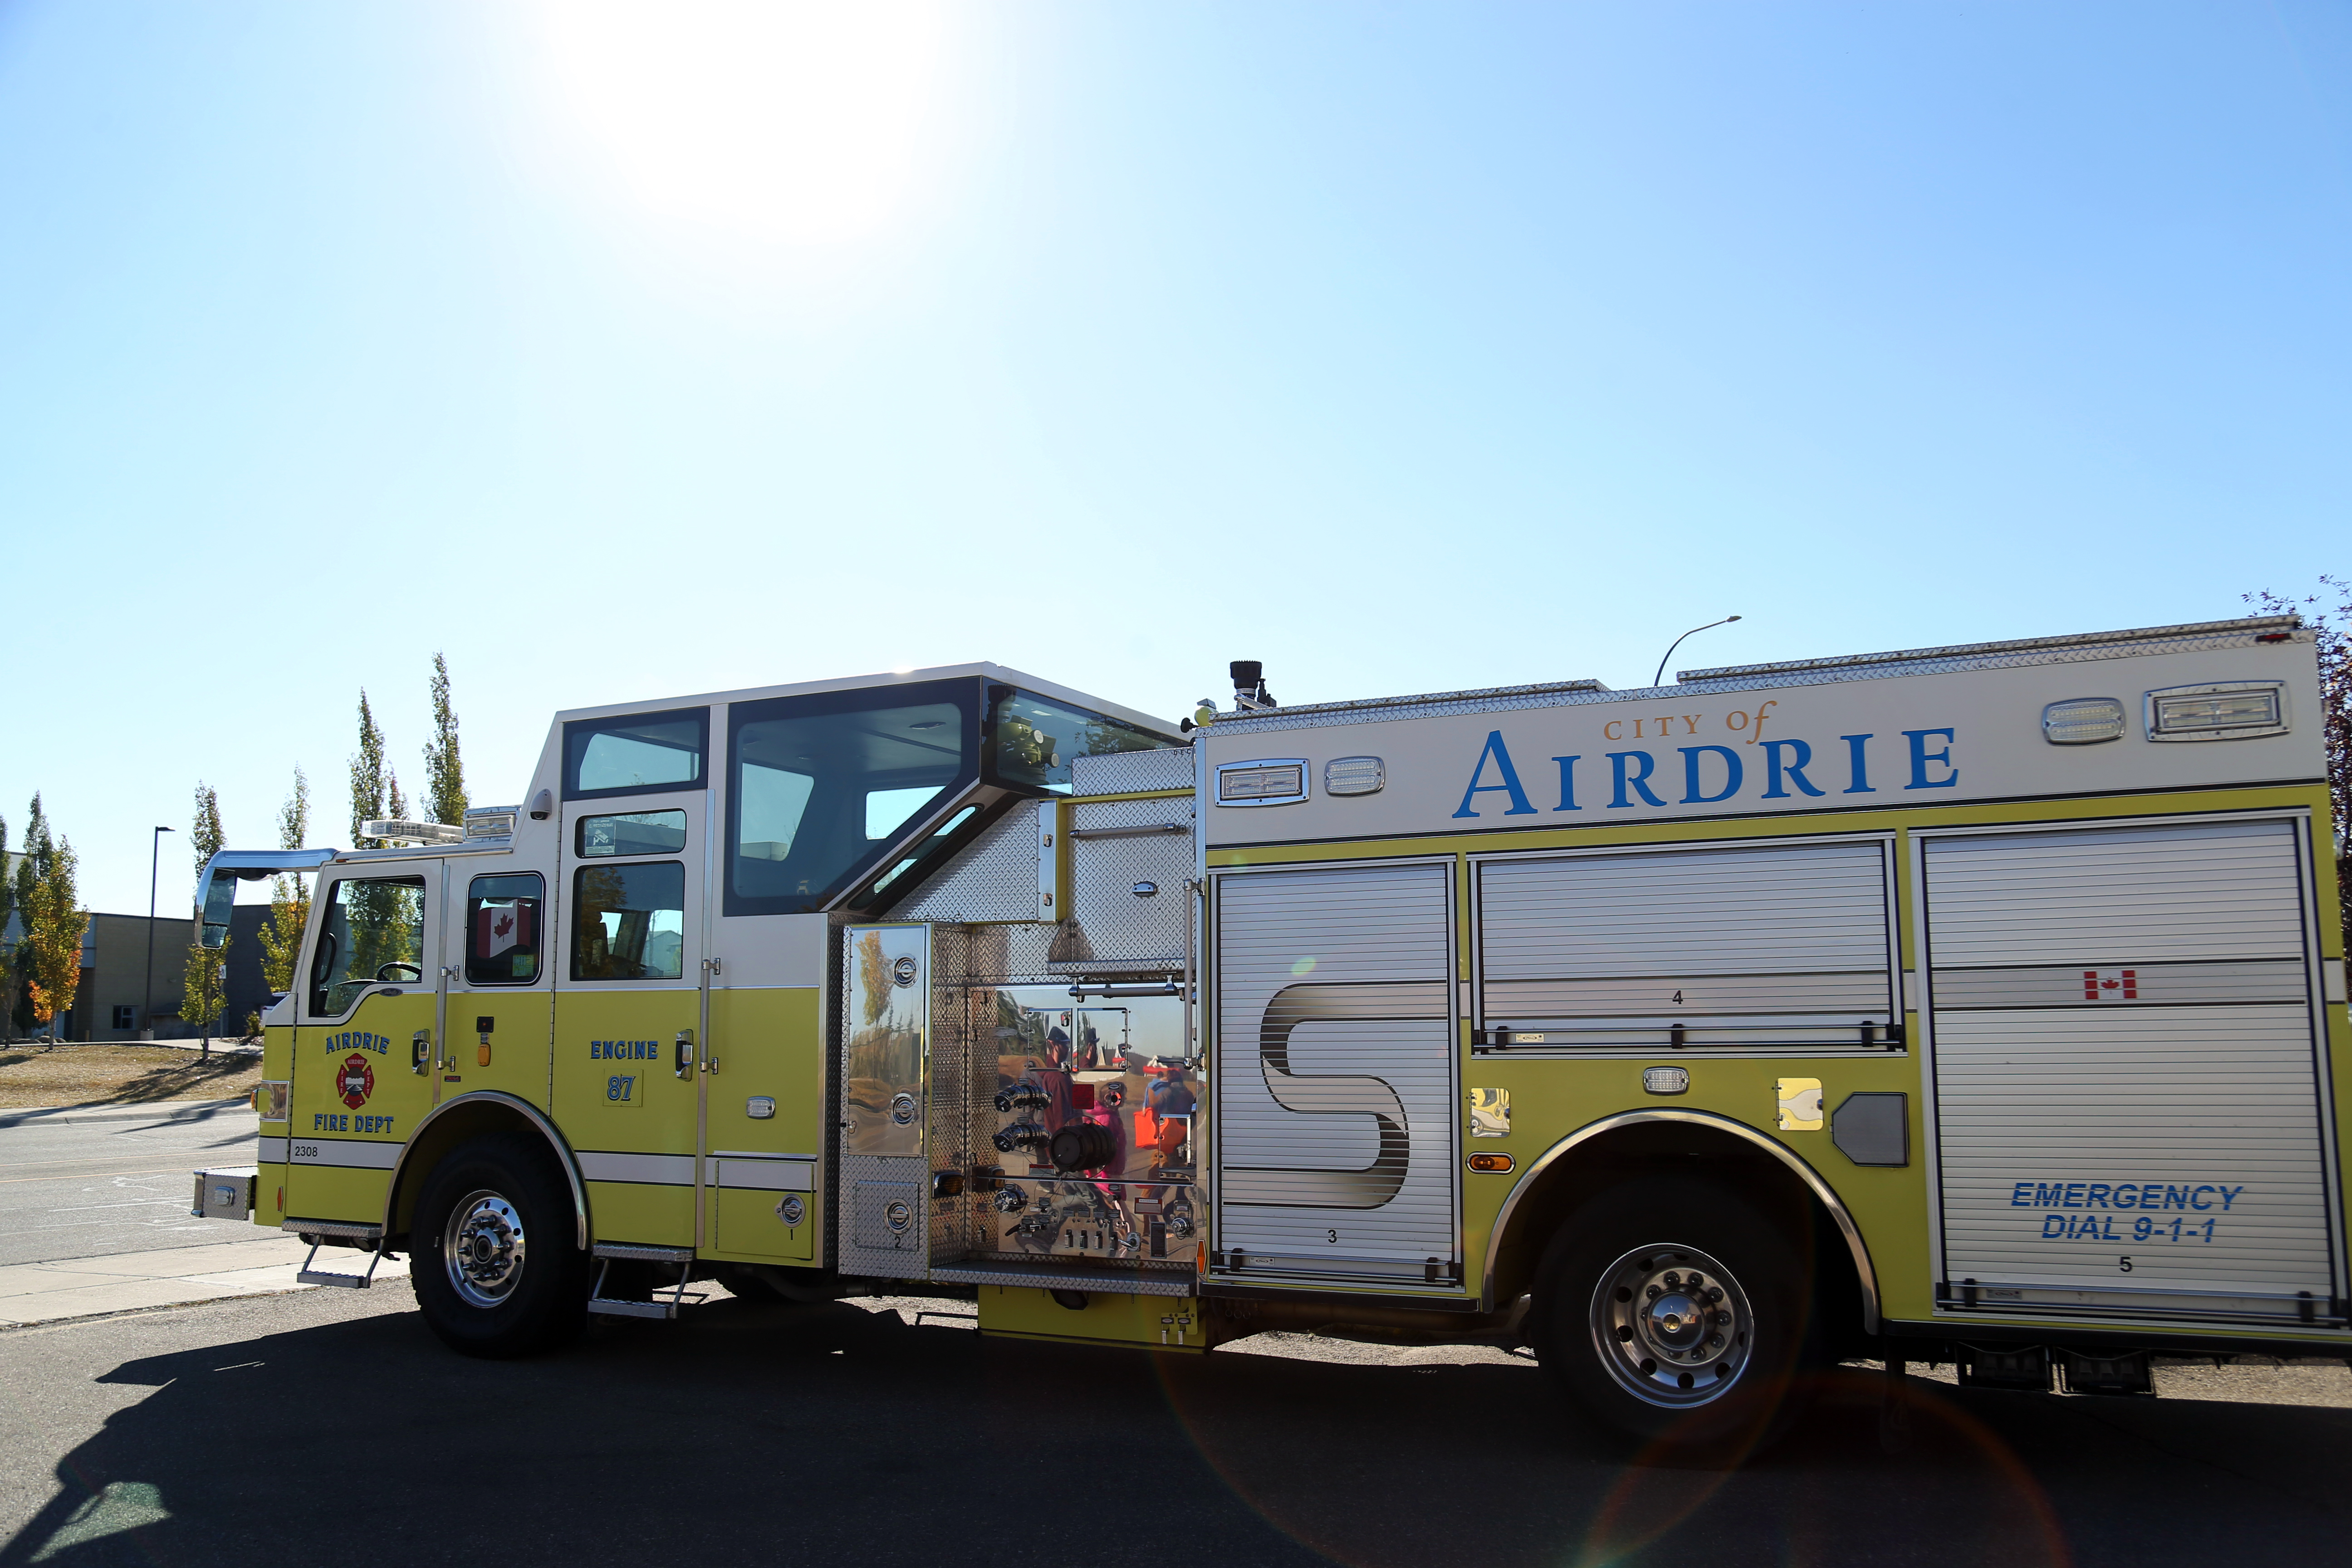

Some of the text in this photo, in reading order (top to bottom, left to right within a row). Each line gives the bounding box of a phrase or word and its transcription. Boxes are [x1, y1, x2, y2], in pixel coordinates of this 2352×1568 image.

[1604, 714, 1702, 740] CITY
[1452, 727, 1959, 819] AIRDRIE
[1672, 990, 1683, 1004] 4
[326, 1031, 391, 1055] AIRDRIE
[590, 1040, 658, 1059] ENGINE
[607, 1073, 637, 1101] 87
[314, 1113, 394, 1133] FIRE DEPT
[295, 1146, 318, 1157] 2308
[2011, 1182, 2244, 1211] EMERGENCY
[790, 1229, 794, 1241] 1
[1328, 1230, 1337, 1243] 3
[2042, 1214, 2215, 1243] DIAL 9-1-1
[894, 1236, 902, 1248] 2
[2119, 1256, 2133, 1273] 5
